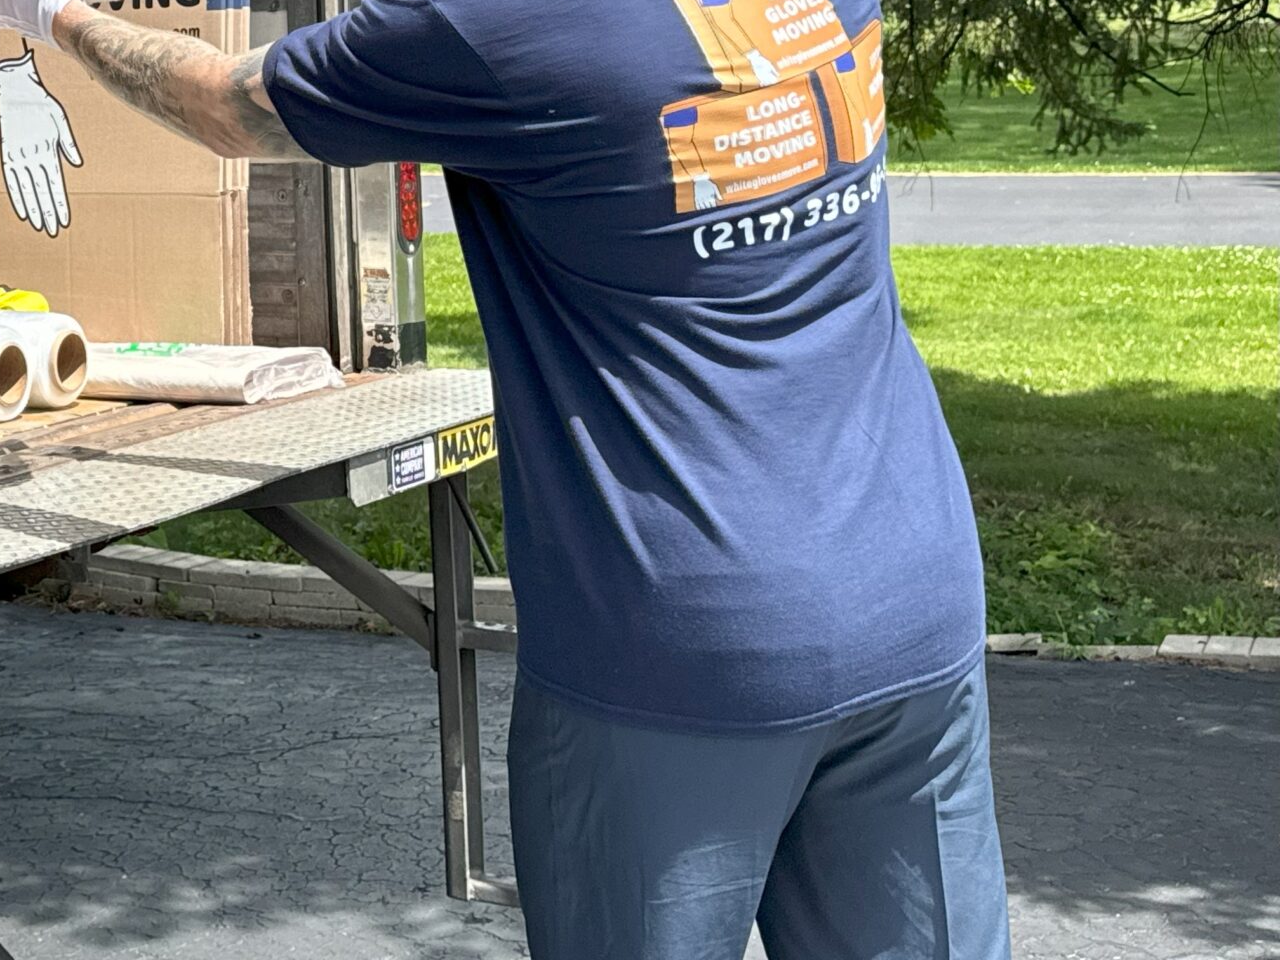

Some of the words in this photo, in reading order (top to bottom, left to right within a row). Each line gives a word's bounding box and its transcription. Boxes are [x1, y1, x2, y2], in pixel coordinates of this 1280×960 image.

[770, 5, 837, 46] MOVING
[745, 91, 807, 122] LONG-
[713, 109, 814, 152] DISTANCE
[734, 130, 817, 169] MOVING
[693, 206, 794, 258] (217)
